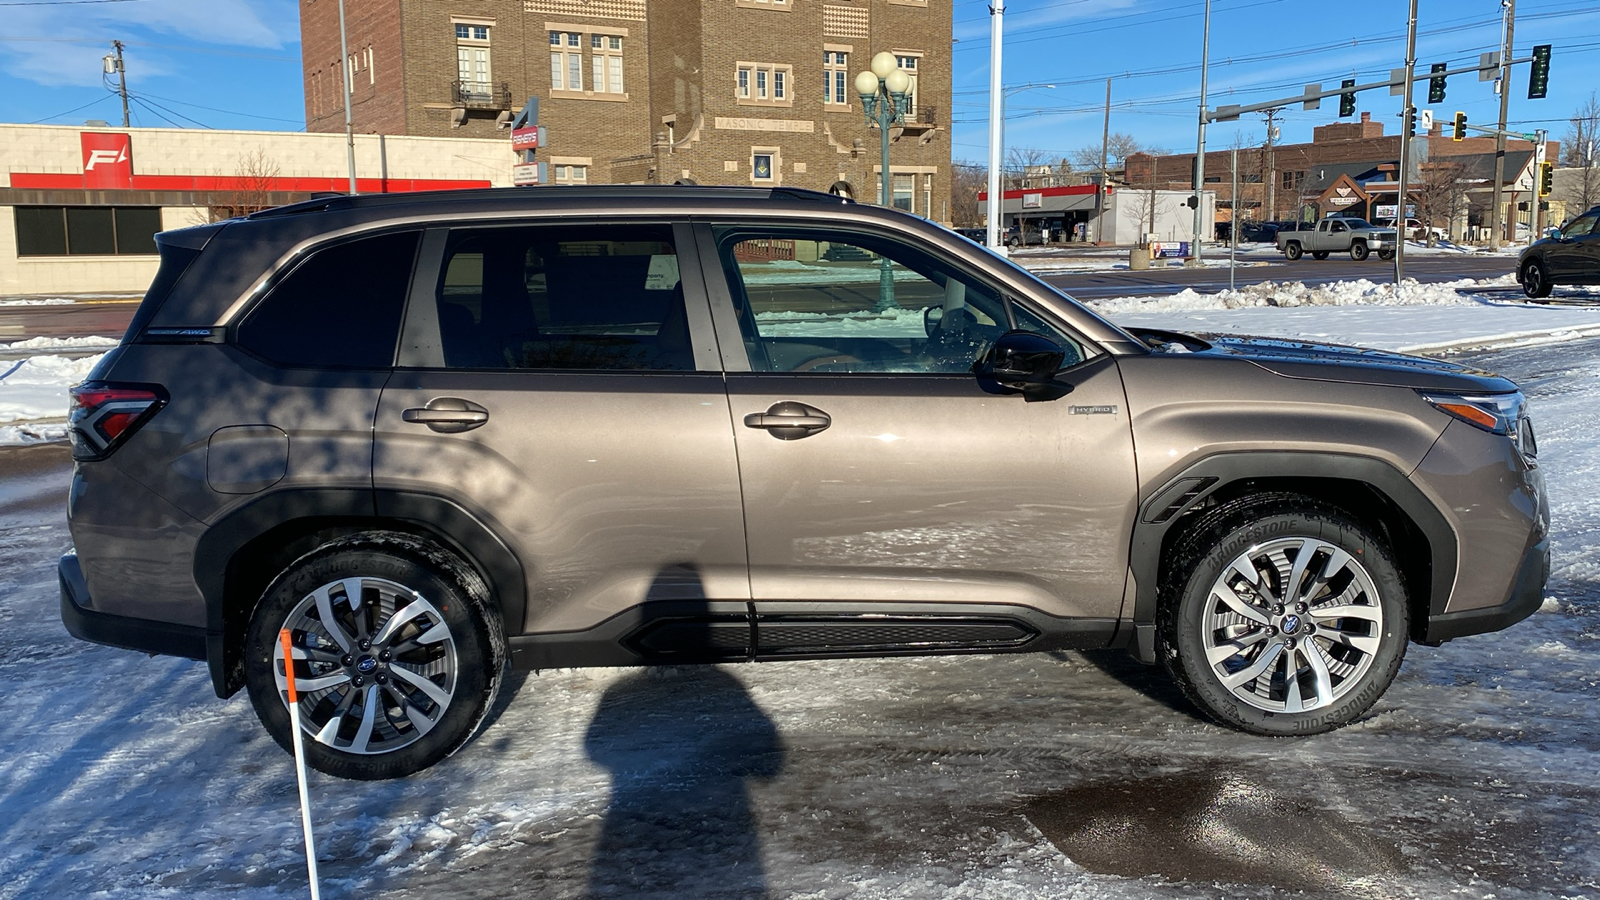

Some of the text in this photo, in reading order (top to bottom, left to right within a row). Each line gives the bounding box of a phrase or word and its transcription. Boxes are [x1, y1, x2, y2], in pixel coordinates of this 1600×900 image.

[717, 119, 813, 131] MASONIC TEMPLE
[1207, 519, 1297, 572] BRIDGESTONE
[1293, 680, 1380, 732] BRIDGESTONE
